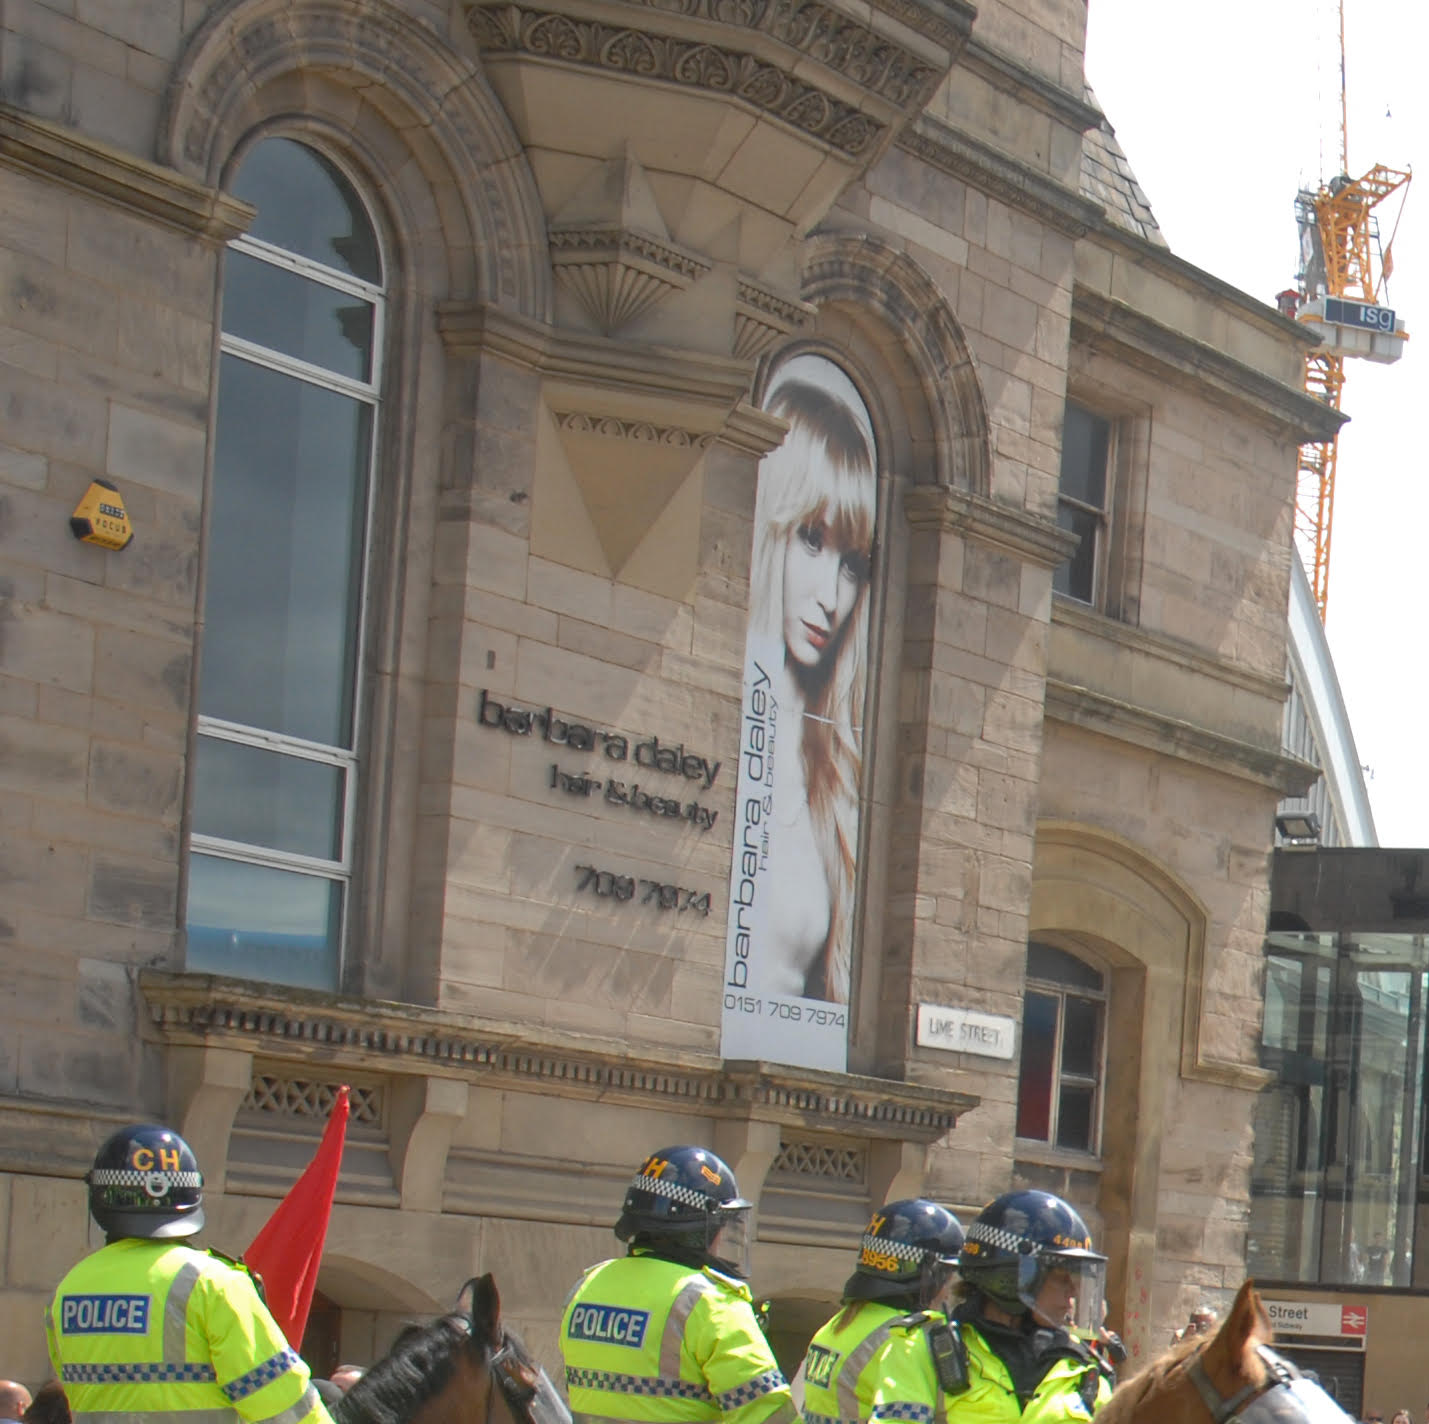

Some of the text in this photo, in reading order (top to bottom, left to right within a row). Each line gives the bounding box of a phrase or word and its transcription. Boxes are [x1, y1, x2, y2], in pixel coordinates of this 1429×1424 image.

[478, 690, 721, 790] barbara daley
[550, 765, 600, 798] hair
[630, 784, 718, 831] beauty
[758, 697, 779, 872] hair & beauty
[728, 660, 772, 989] barbara daley
[575, 864, 713, 917] 709 7974
[724, 994, 846, 1030] 0151 709 7974
[928, 1018, 1001, 1046] LIME STREET
[132, 1148, 181, 1172] CH
[62, 1295, 150, 1334] POLICE
[570, 1304, 650, 1349] POLICE
[1268, 1305, 1308, 1320] Street
